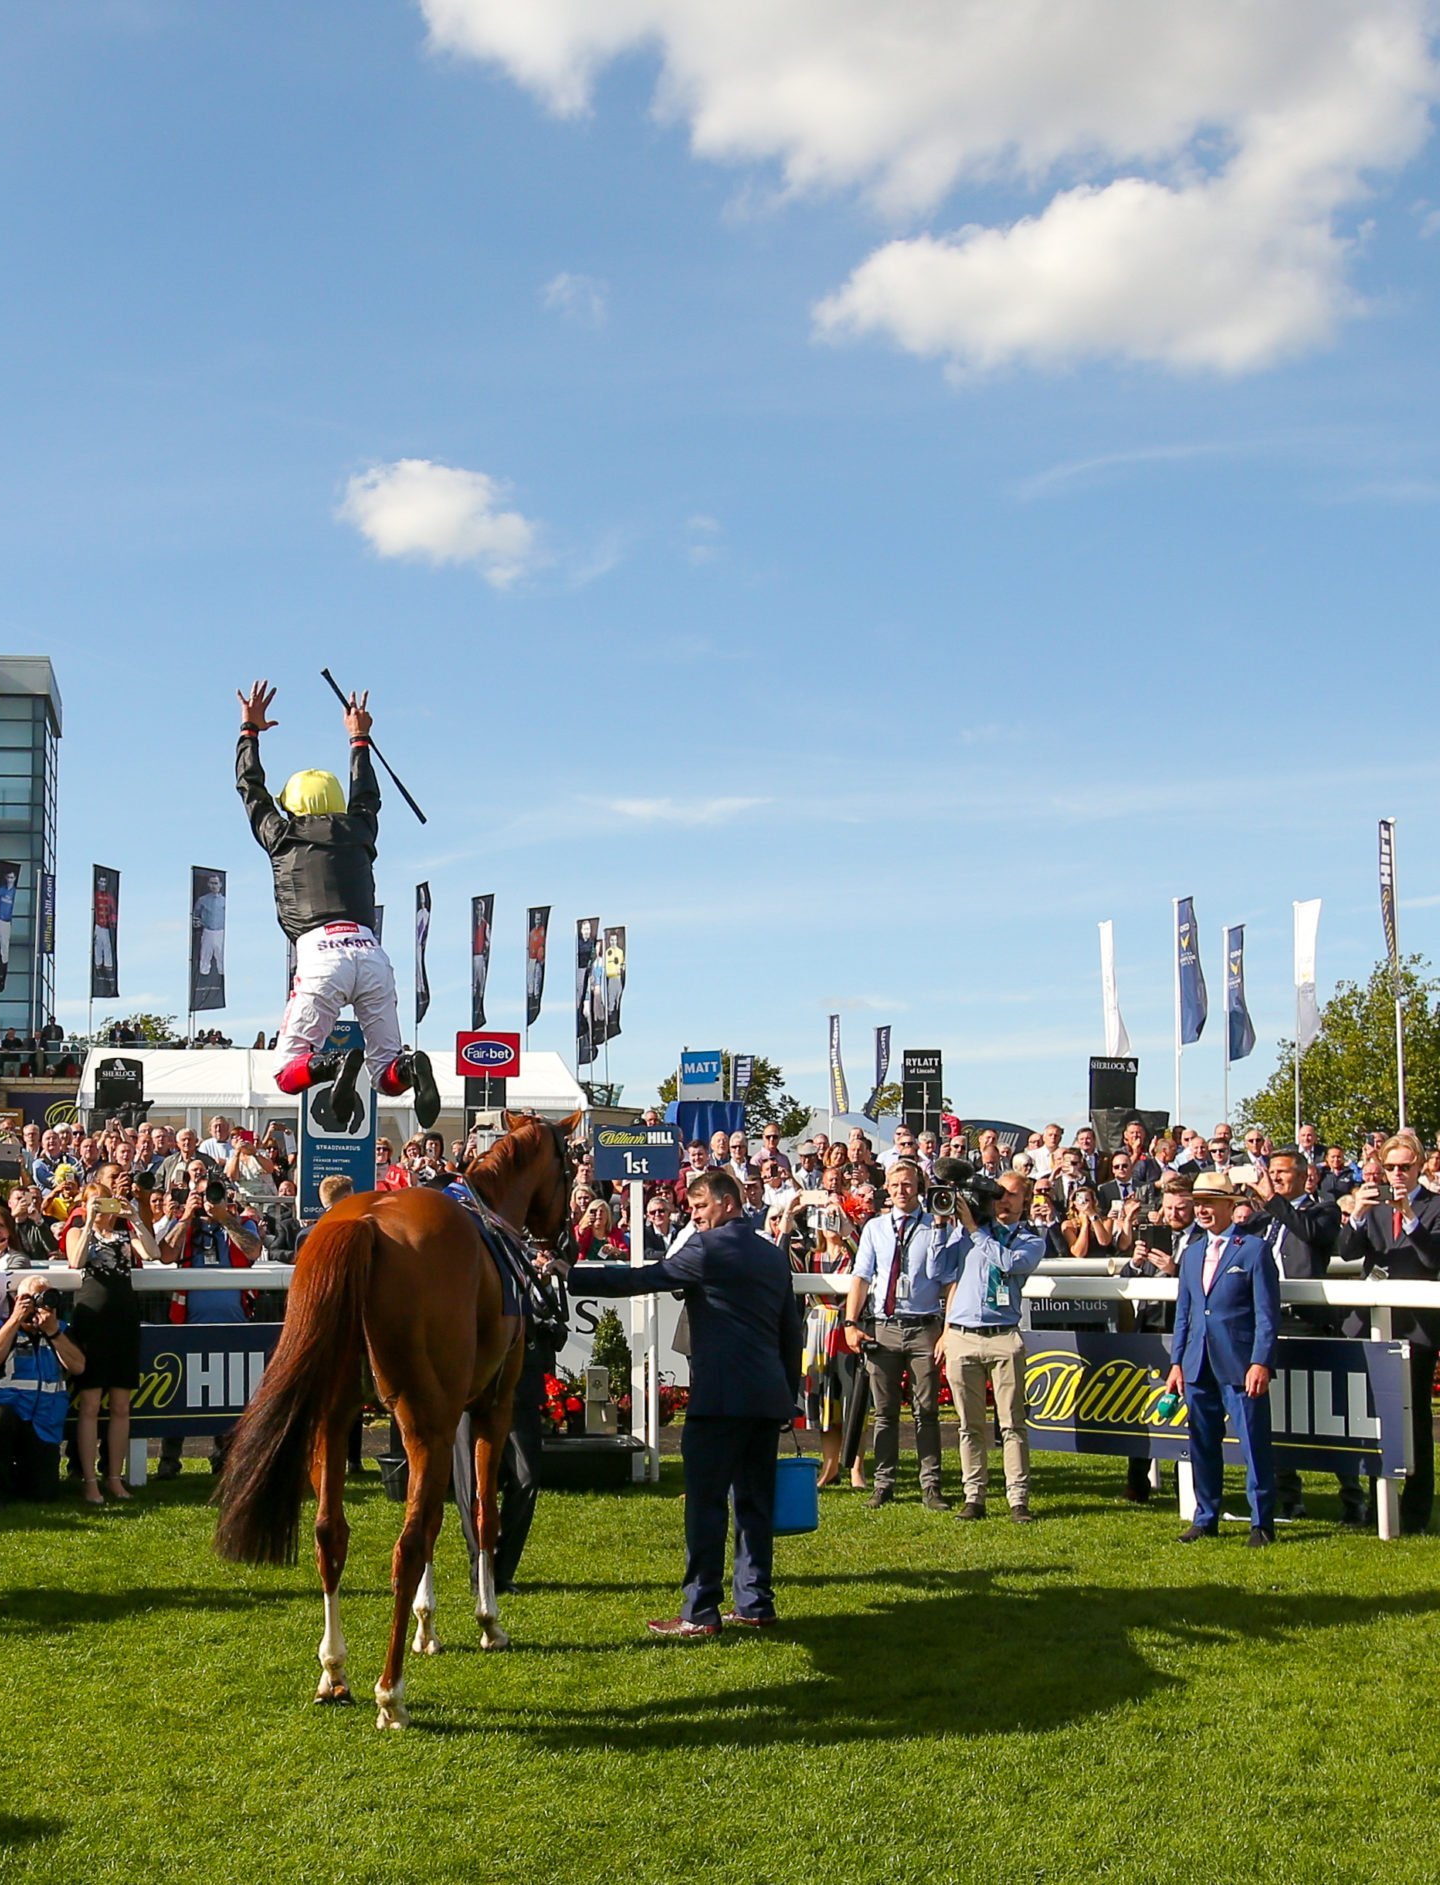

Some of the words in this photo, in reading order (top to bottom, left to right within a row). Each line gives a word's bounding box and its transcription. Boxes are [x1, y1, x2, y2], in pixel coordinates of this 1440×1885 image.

[44, 876, 53, 951] williamhill.com
[334, 1024, 351, 1032] IPCO
[684, 1061, 718, 1074] MATT
[905, 1057, 940, 1067] RYLATT
[736, 1057, 752, 1087] HILL
[598, 1130, 647, 1147] William
[647, 1132, 674, 1144] HILL
[315, 1144, 361, 1152] STRADIVARIUS
[623, 1151, 649, 1174] 1st
[1029, 1300, 1070, 1312] tallion
[1073, 1300, 1108, 1311] Studs
[1024, 1350, 1230, 1427] Willia
